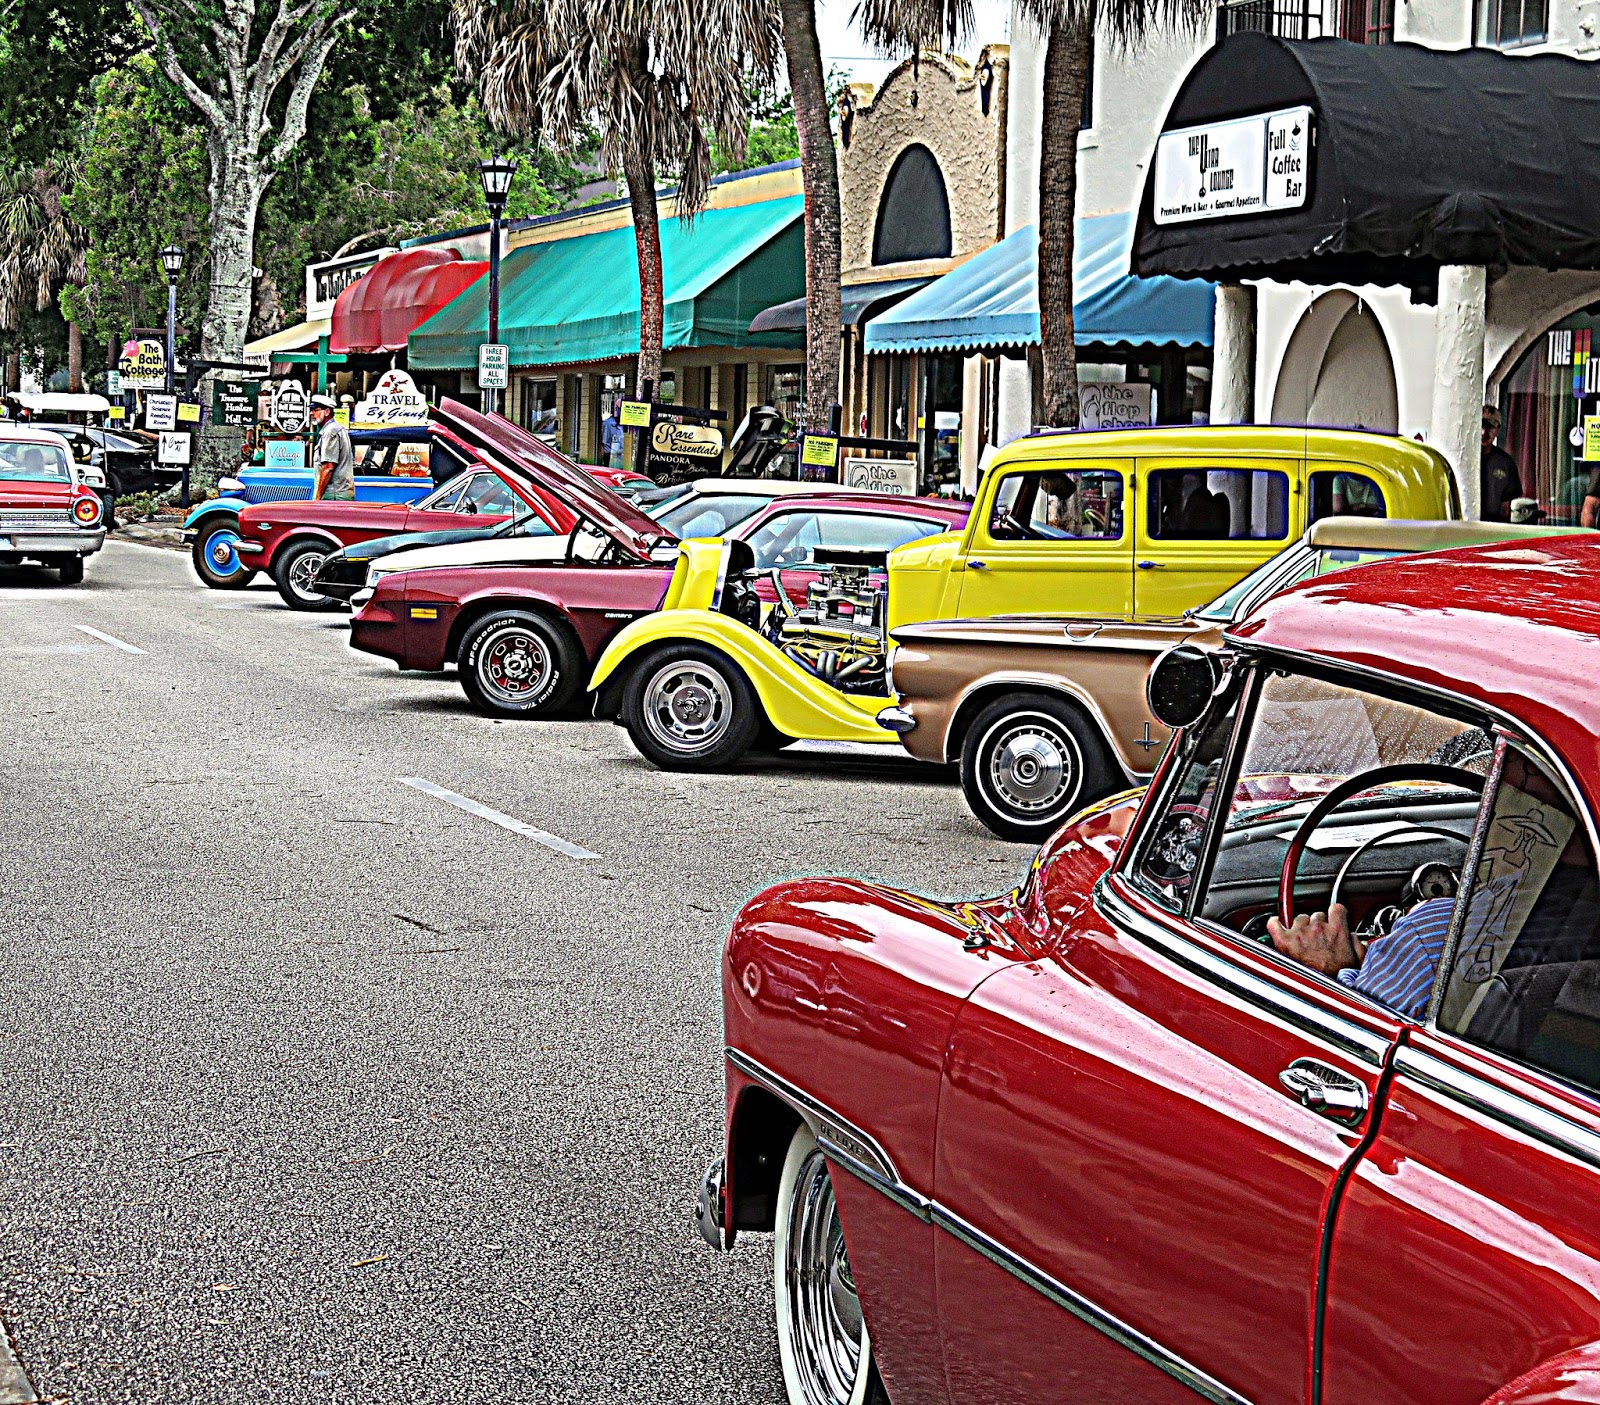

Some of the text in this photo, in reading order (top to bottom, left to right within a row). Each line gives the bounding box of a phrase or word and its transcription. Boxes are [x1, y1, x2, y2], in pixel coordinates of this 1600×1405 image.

[1188, 135, 1199, 157] THE
[1269, 129, 1286, 151] Full
[1272, 154, 1301, 175] Coffee
[1210, 168, 1234, 192] LOUNGE
[1286, 178, 1302, 198] Bar
[1160, 207, 1180, 216] Premium
[1181, 204, 1192, 214] Wine
[1198, 202, 1208, 211] Beer
[1215, 199, 1235, 209] Gourmet
[1236, 196, 1260, 207] Appetizers
[144, 343, 159, 353] The
[1548, 330, 1571, 365] THE
[138, 353, 162, 365] Bath
[125, 363, 165, 378] Cottage
[227, 384, 243, 393] The
[1102, 385, 1133, 400] the
[219, 393, 249, 403] Treasure
[372, 394, 419, 406] TRAVEL
[225, 403, 253, 412] Hunters
[366, 406, 425, 420] By Ginny
[1102, 401, 1140, 419] flop
[150, 412, 172, 420] Reading
[225, 414, 242, 424] Mall
[655, 424, 695, 444] Rare
[670, 440, 718, 456] Essentials
[649, 454, 691, 465] PANDORA
[870, 466, 897, 480] the
[468, 619, 516, 667] BFGoodrich
[520, 670, 560, 710] Radial T/A
